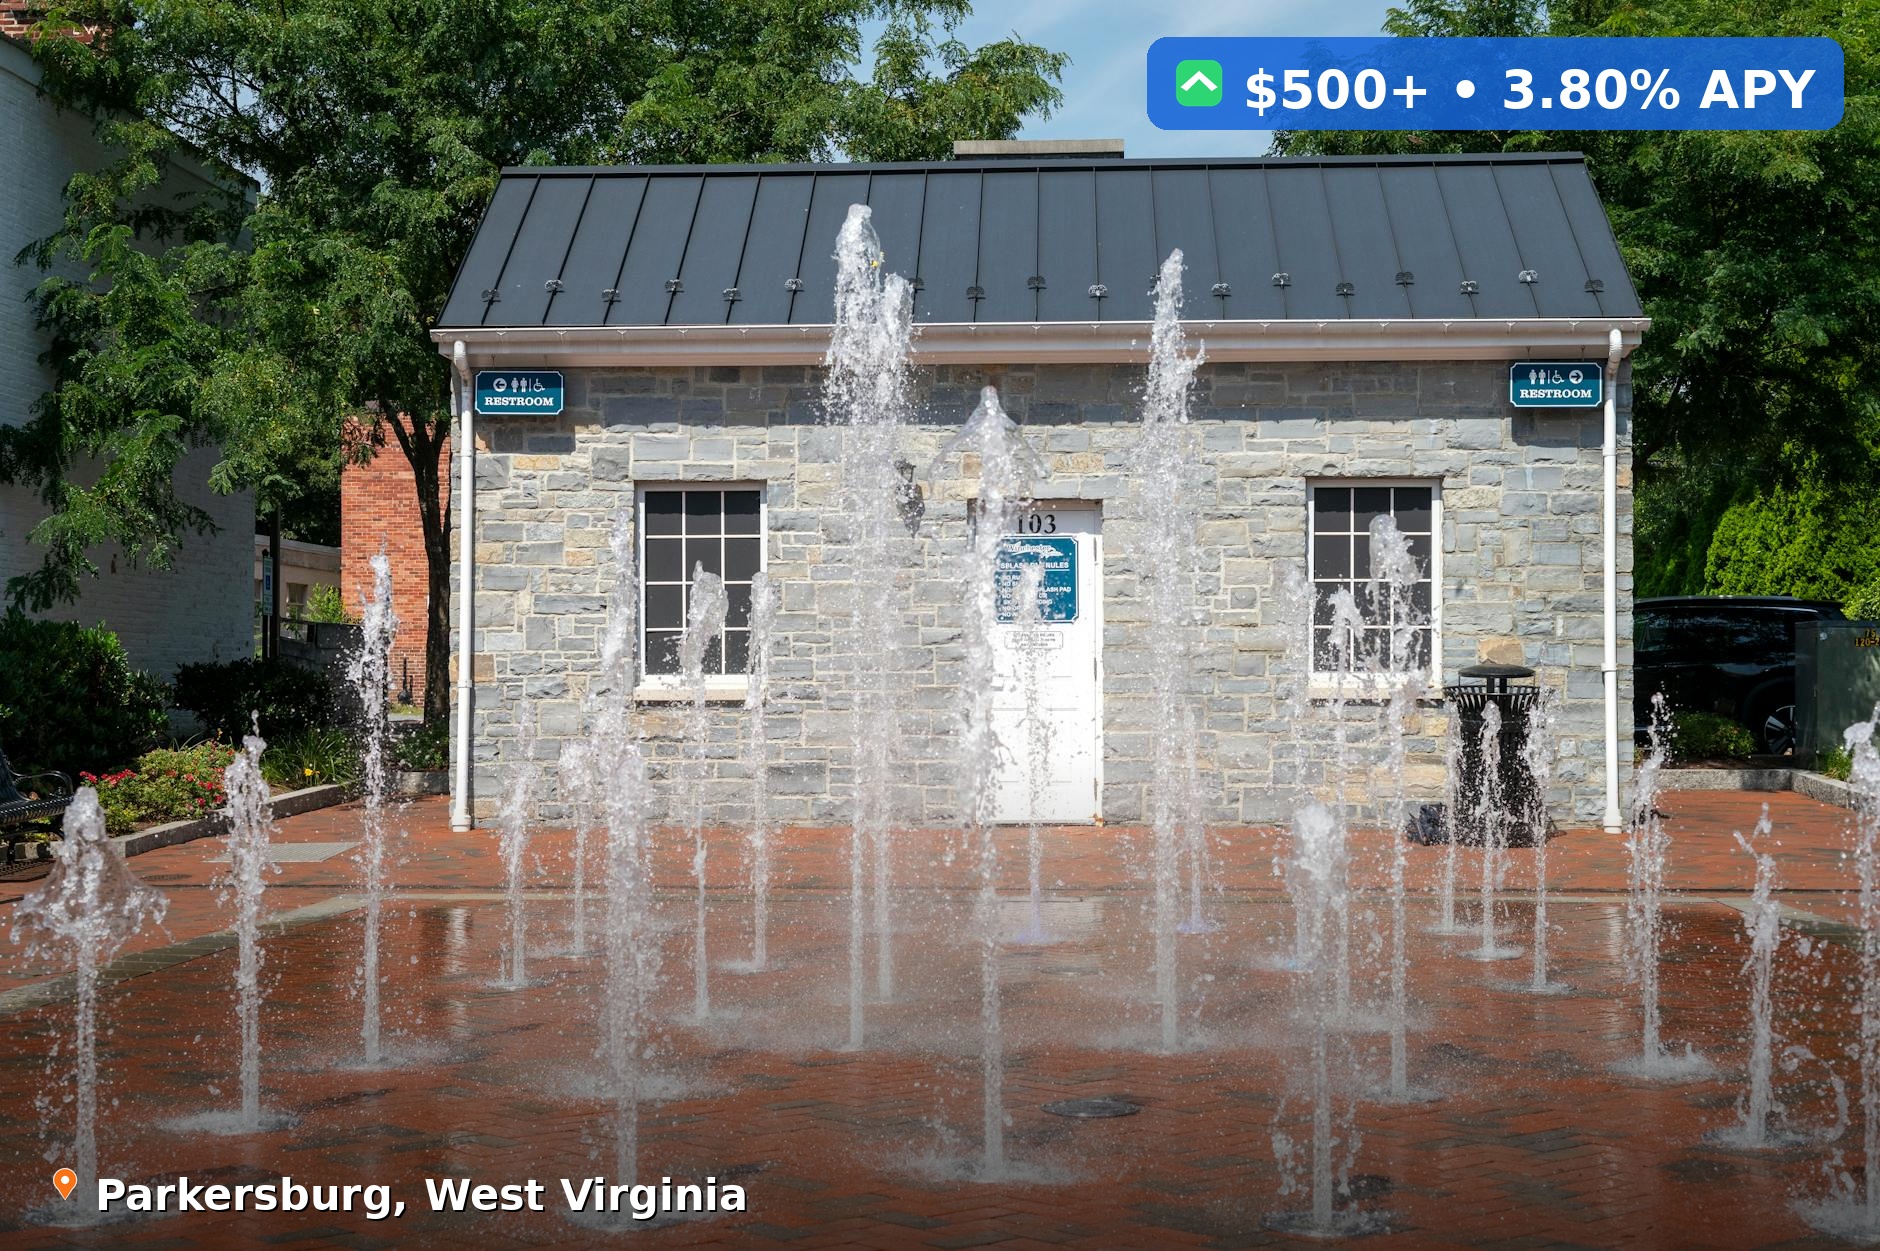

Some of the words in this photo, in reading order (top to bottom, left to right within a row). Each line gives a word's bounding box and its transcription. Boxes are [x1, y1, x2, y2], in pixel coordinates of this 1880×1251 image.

[1520, 389, 1592, 398] RESTROOM
[484, 397, 554, 406] RESTROOM
[1016, 514, 1056, 534] 103
